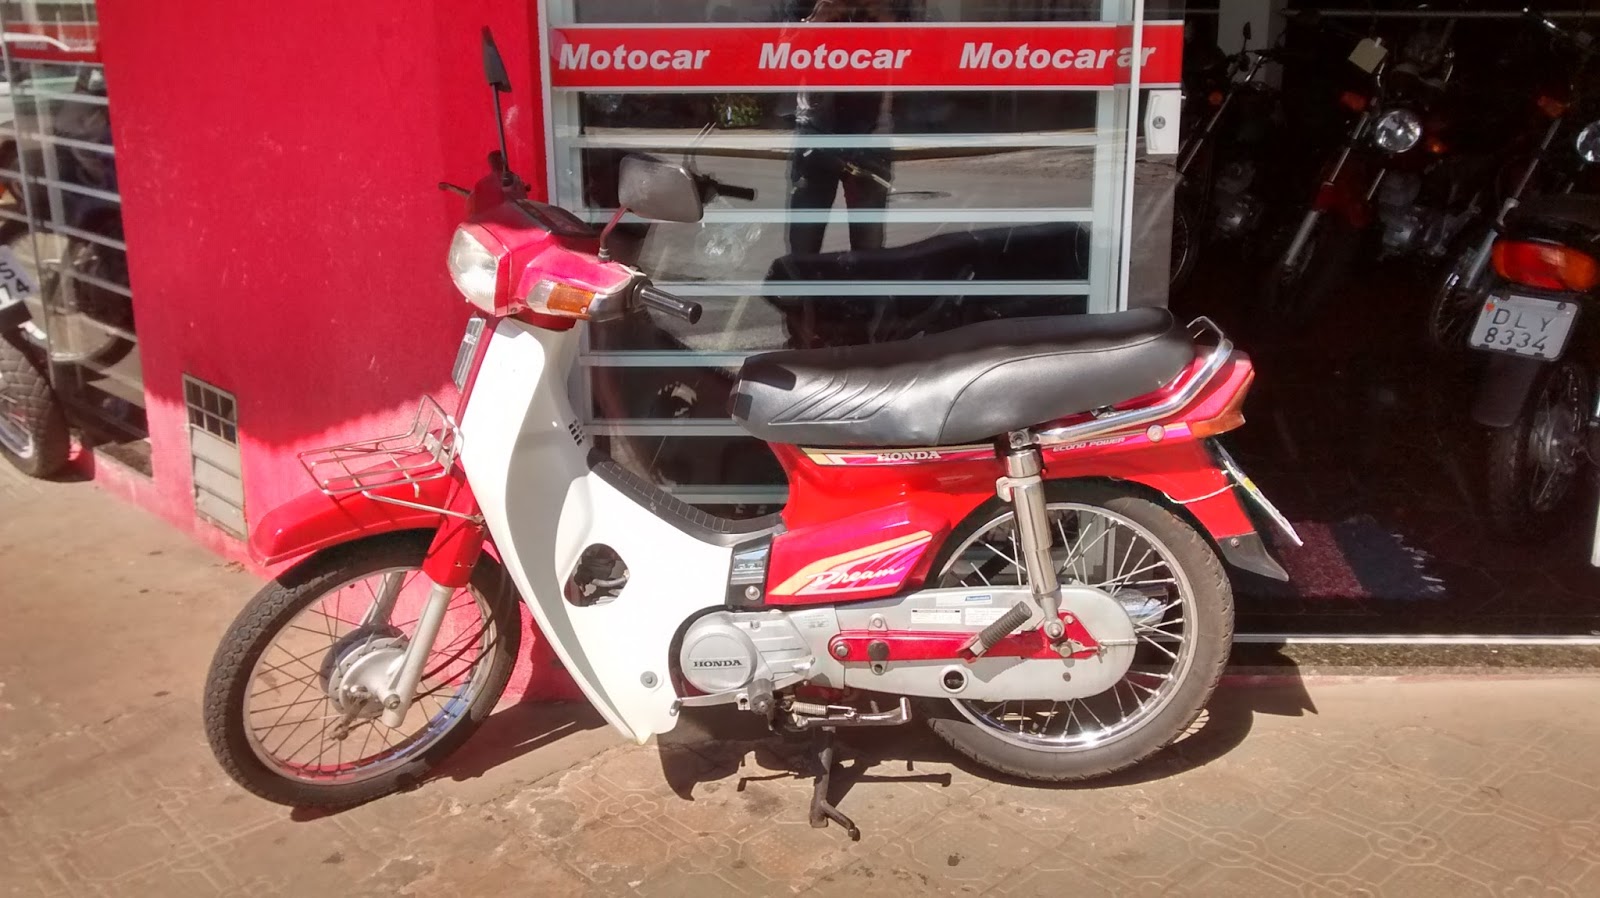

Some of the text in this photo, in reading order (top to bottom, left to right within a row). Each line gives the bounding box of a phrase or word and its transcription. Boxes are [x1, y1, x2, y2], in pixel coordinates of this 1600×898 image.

[558, 43, 709, 71] Motocar
[758, 43, 911, 70] Motocar
[959, 42, 1115, 70] Motocar
[1492, 308, 1552, 332] DLY
[1484, 327, 1548, 351] 8334
[1089, 437, 1126, 447] POWER
[876, 450, 942, 461] HONDA
[806, 566, 906, 587] Dream
[693, 659, 743, 668] HONDA
